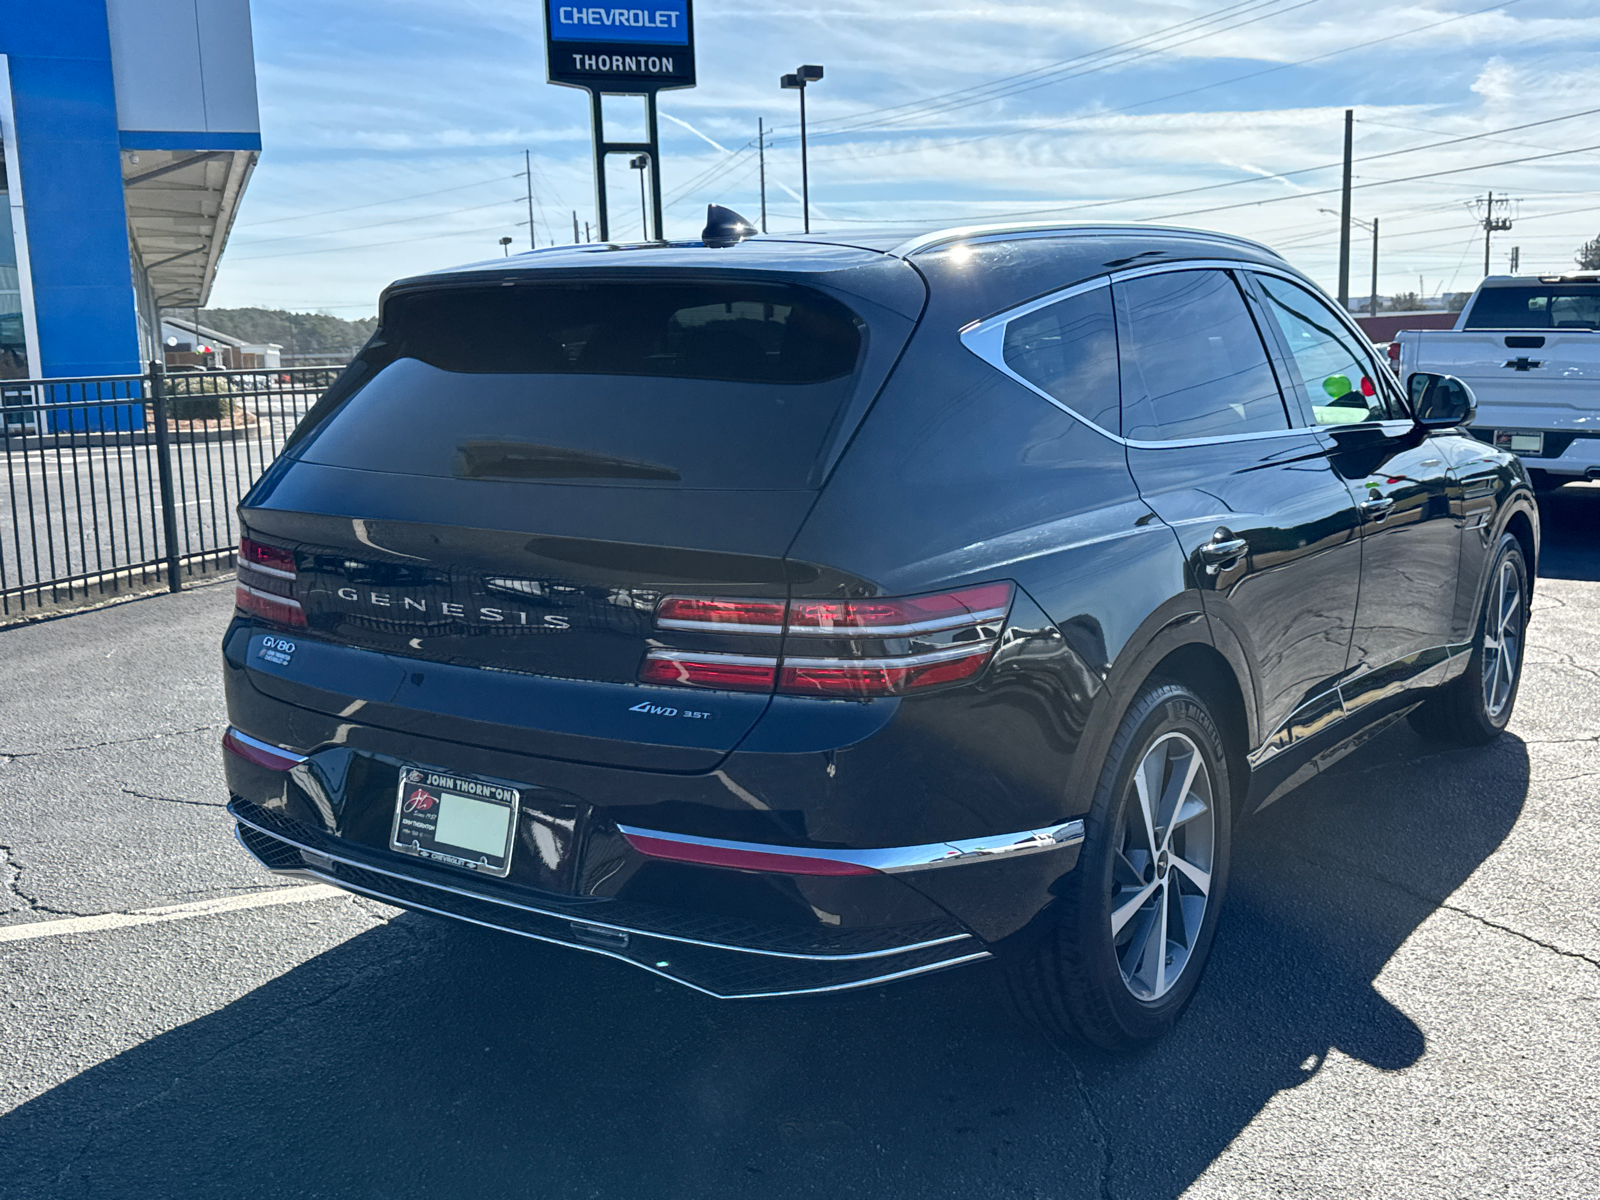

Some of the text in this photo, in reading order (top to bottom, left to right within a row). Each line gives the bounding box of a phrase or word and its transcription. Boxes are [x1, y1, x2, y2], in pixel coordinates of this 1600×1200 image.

[559, 6, 680, 28] CHEVROLET
[572, 53, 674, 73] THORNTON
[337, 587, 571, 629] GENESIS
[262, 636, 296, 653] GV80
[628, 701, 678, 717] 4WD
[1187, 704, 1224, 759] MICHELIN
[426, 774, 454, 789] JOHN
